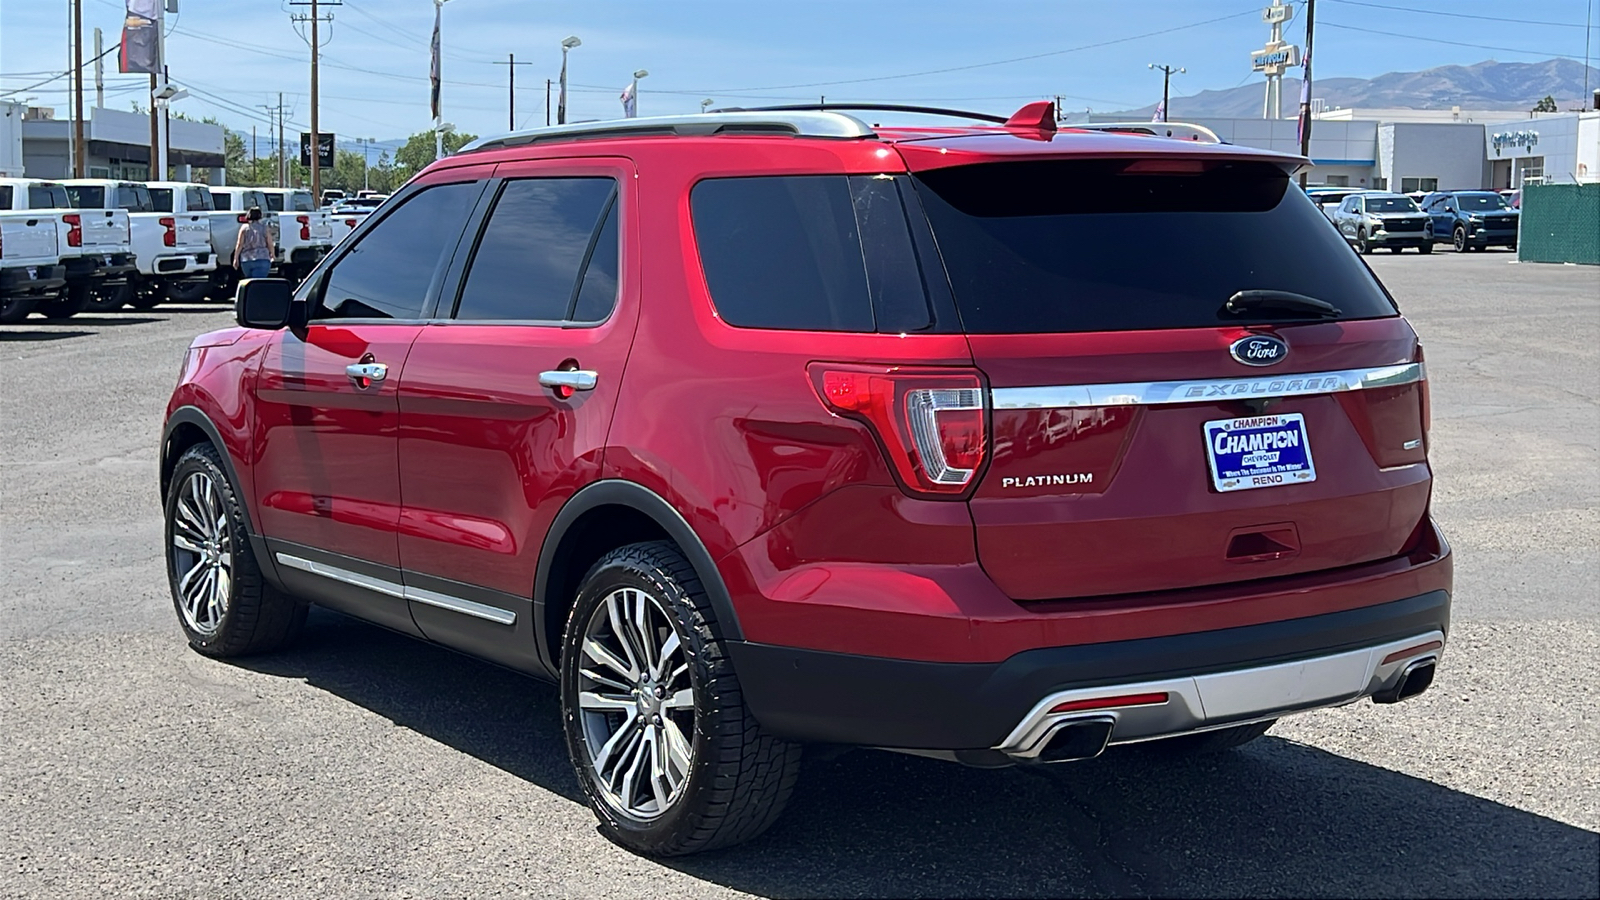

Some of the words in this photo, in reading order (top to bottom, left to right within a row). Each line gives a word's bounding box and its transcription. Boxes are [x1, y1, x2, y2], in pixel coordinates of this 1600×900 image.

[1247, 340, 1278, 359] Ford
[1185, 377, 1339, 398] EXPLORER
[1233, 416, 1279, 429] CHAMPION
[1214, 430, 1299, 455] CHAMPION
[1243, 453, 1278, 464] CHEVROLET
[1002, 473, 1093, 488] PLATINUM
[1252, 475, 1283, 486] RENO
